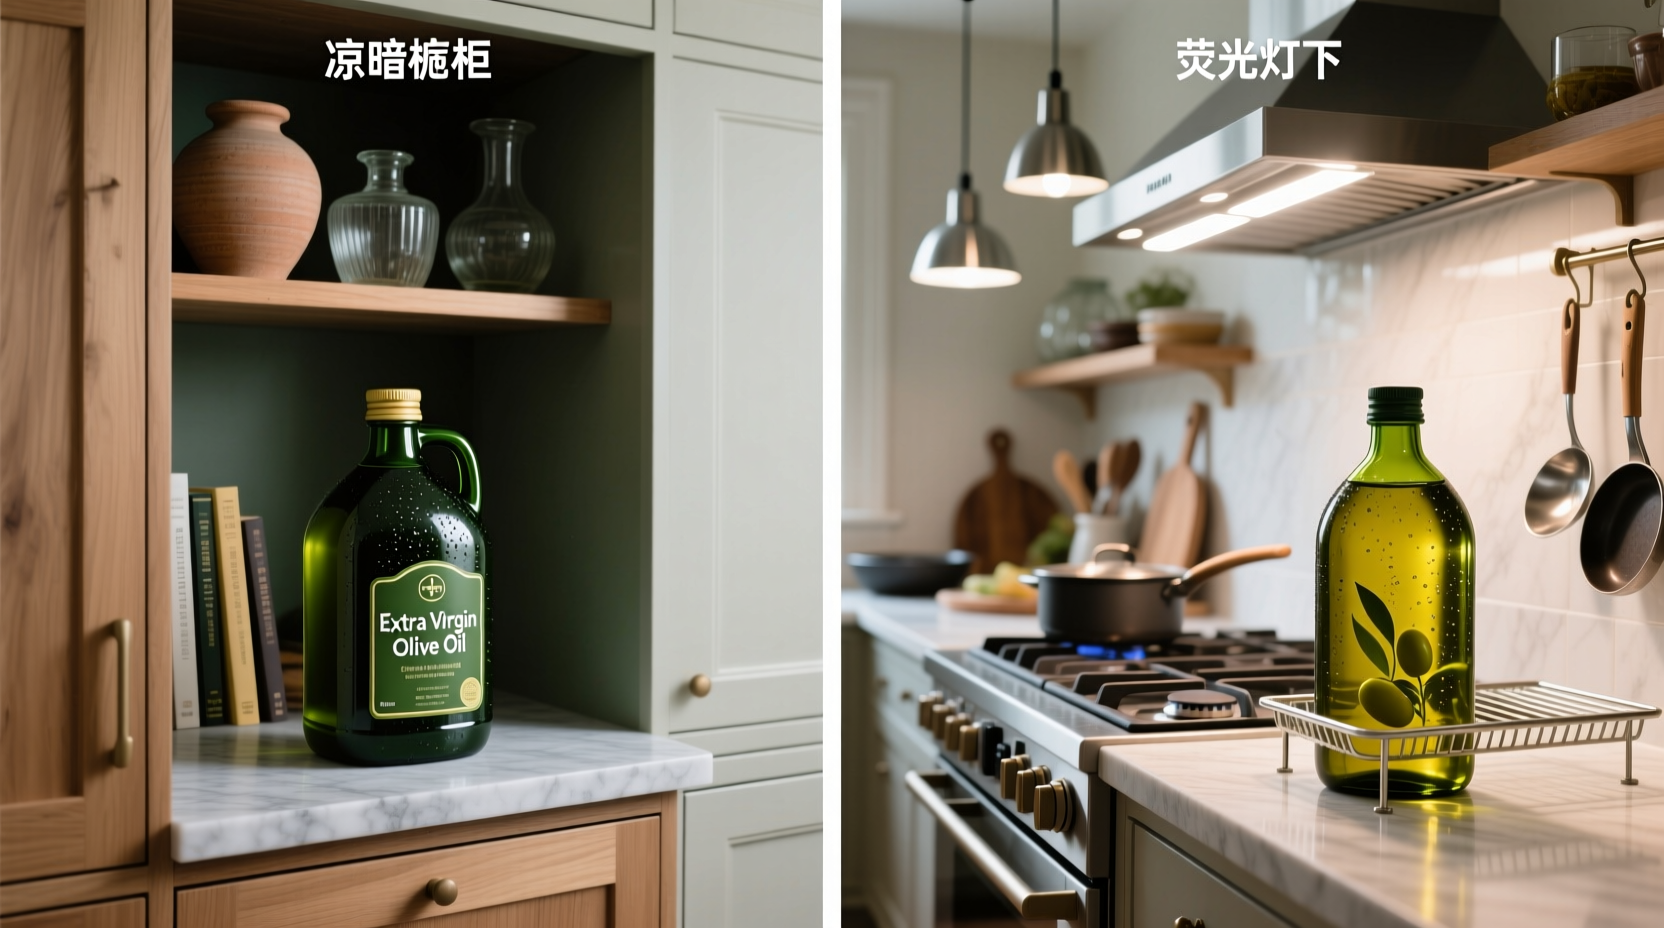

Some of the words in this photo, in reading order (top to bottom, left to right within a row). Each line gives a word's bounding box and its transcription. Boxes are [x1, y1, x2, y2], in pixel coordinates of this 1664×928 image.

[380, 613, 427, 633] Extra
[430, 610, 477, 634] Virgin
[392, 636, 440, 657] Olive
[443, 632, 466, 654] Oil
